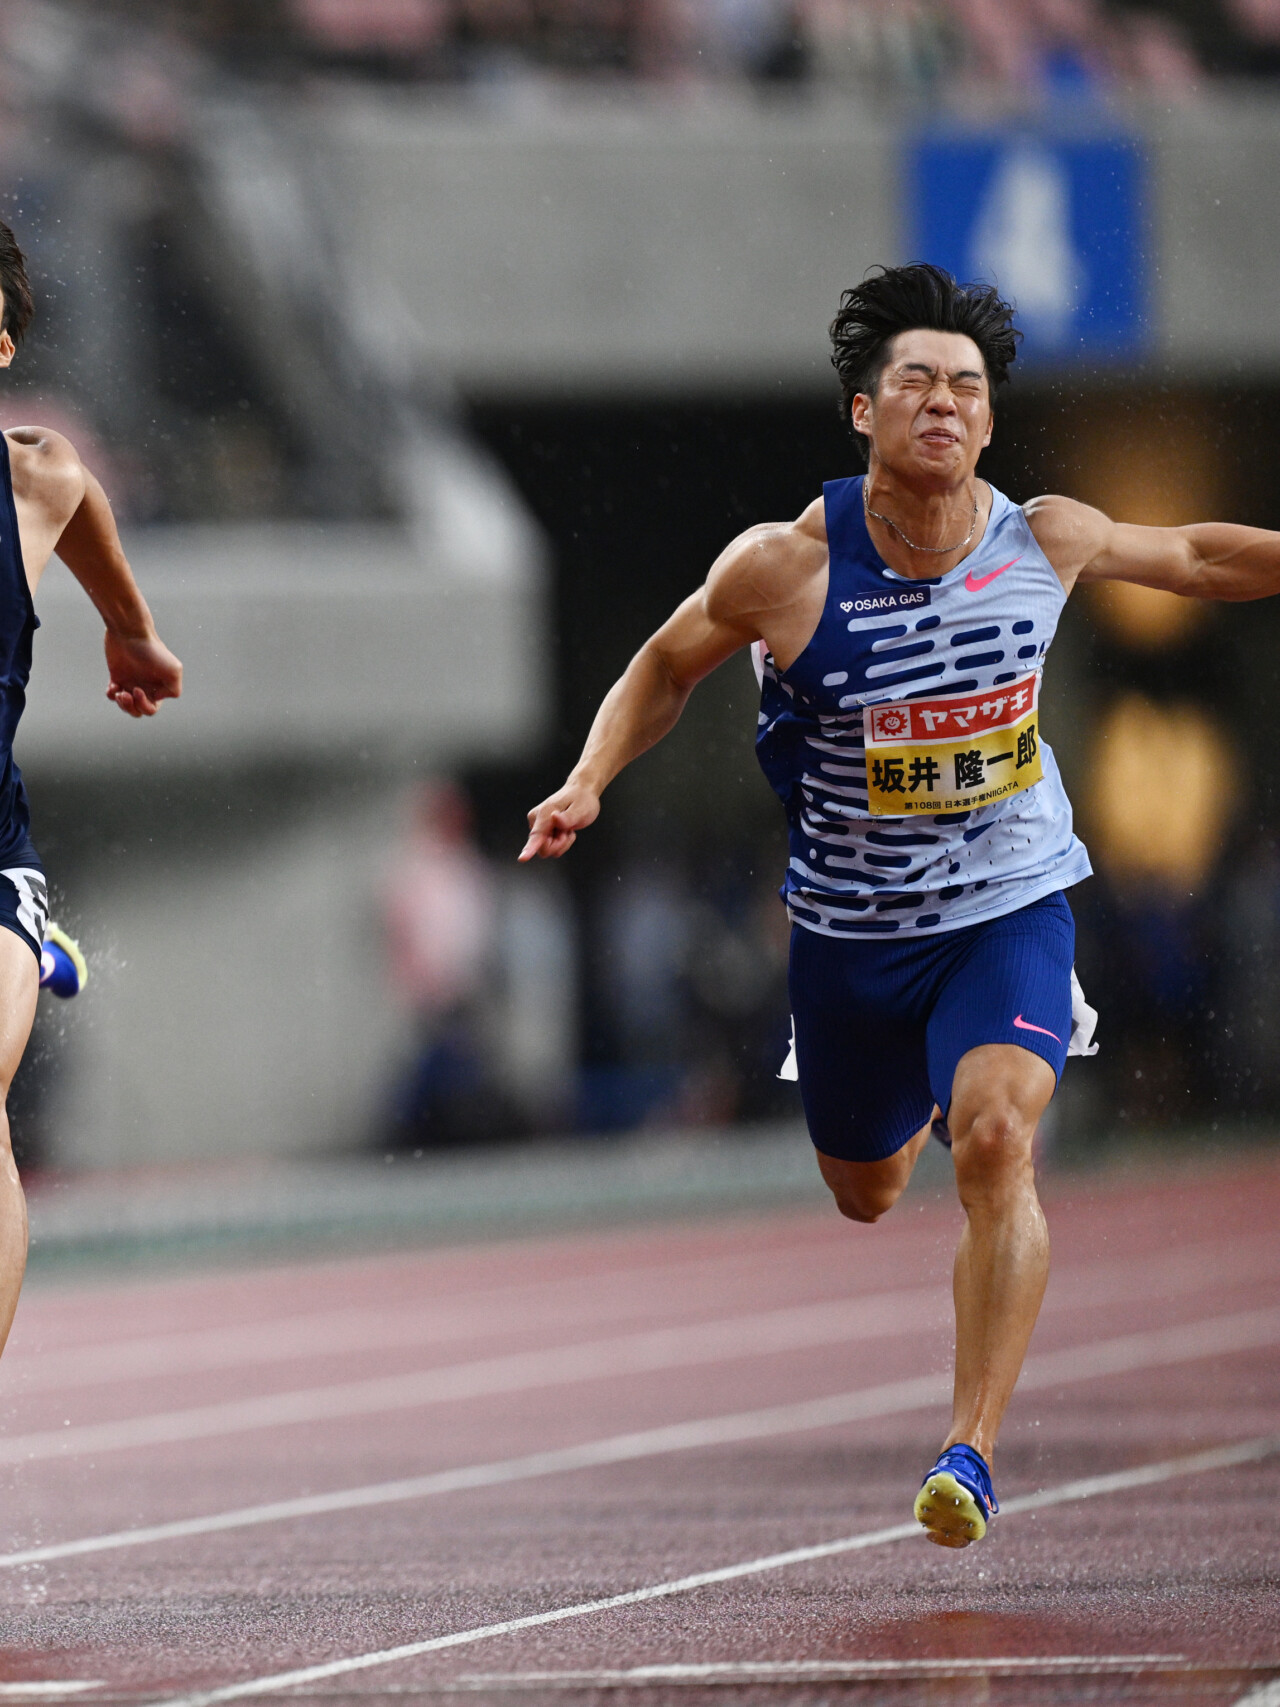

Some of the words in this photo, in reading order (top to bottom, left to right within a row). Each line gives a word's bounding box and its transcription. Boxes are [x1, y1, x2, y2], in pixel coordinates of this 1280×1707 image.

[854, 596, 897, 612] OSAKA
[899, 592, 924, 605] GAS
[919, 687, 1029, 731] ヤマザキ
[871, 757, 941, 794] 坂井
[954, 724, 1037, 790] 隆一郎
[904, 801, 942, 811] 第108回
